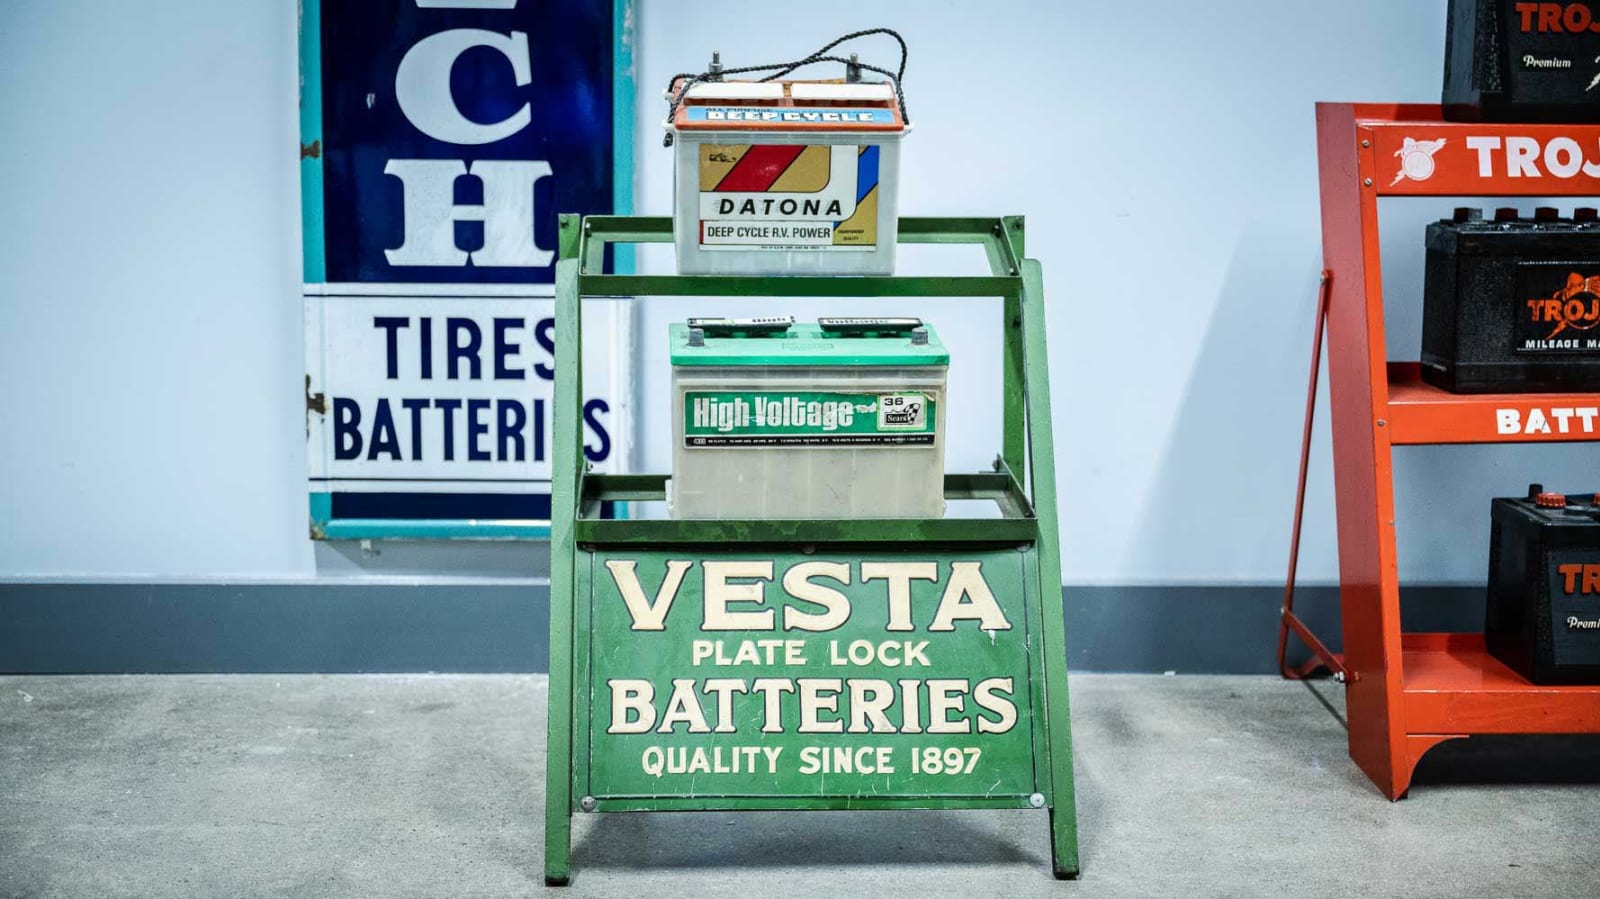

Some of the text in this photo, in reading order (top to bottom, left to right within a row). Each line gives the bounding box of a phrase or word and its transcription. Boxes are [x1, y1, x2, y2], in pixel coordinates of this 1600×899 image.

[1523, 54, 1572, 68] Premium
[706, 111, 875, 122] DEEP CYCLE
[719, 198, 842, 216] DATONA
[707, 226, 734, 238] DEEP
[737, 227, 769, 238] CYCLE
[772, 227, 790, 239] R.V.
[792, 227, 831, 239] POWER
[374, 316, 555, 380] TIRES
[1525, 339, 1579, 349] MILEAGE
[693, 395, 855, 432] High Voltage
[884, 397, 904, 406] 36
[333, 398, 611, 462] BATTERIS
[887, 414, 908, 422] Sears
[1496, 408, 1598, 434] BATT
[605, 559, 1013, 632] VESTA
[693, 640, 931, 666] PLATE LOCK
[607, 677, 1018, 735] BATTERIES
[641, 746, 982, 777] QUALITY SINCE 1897
